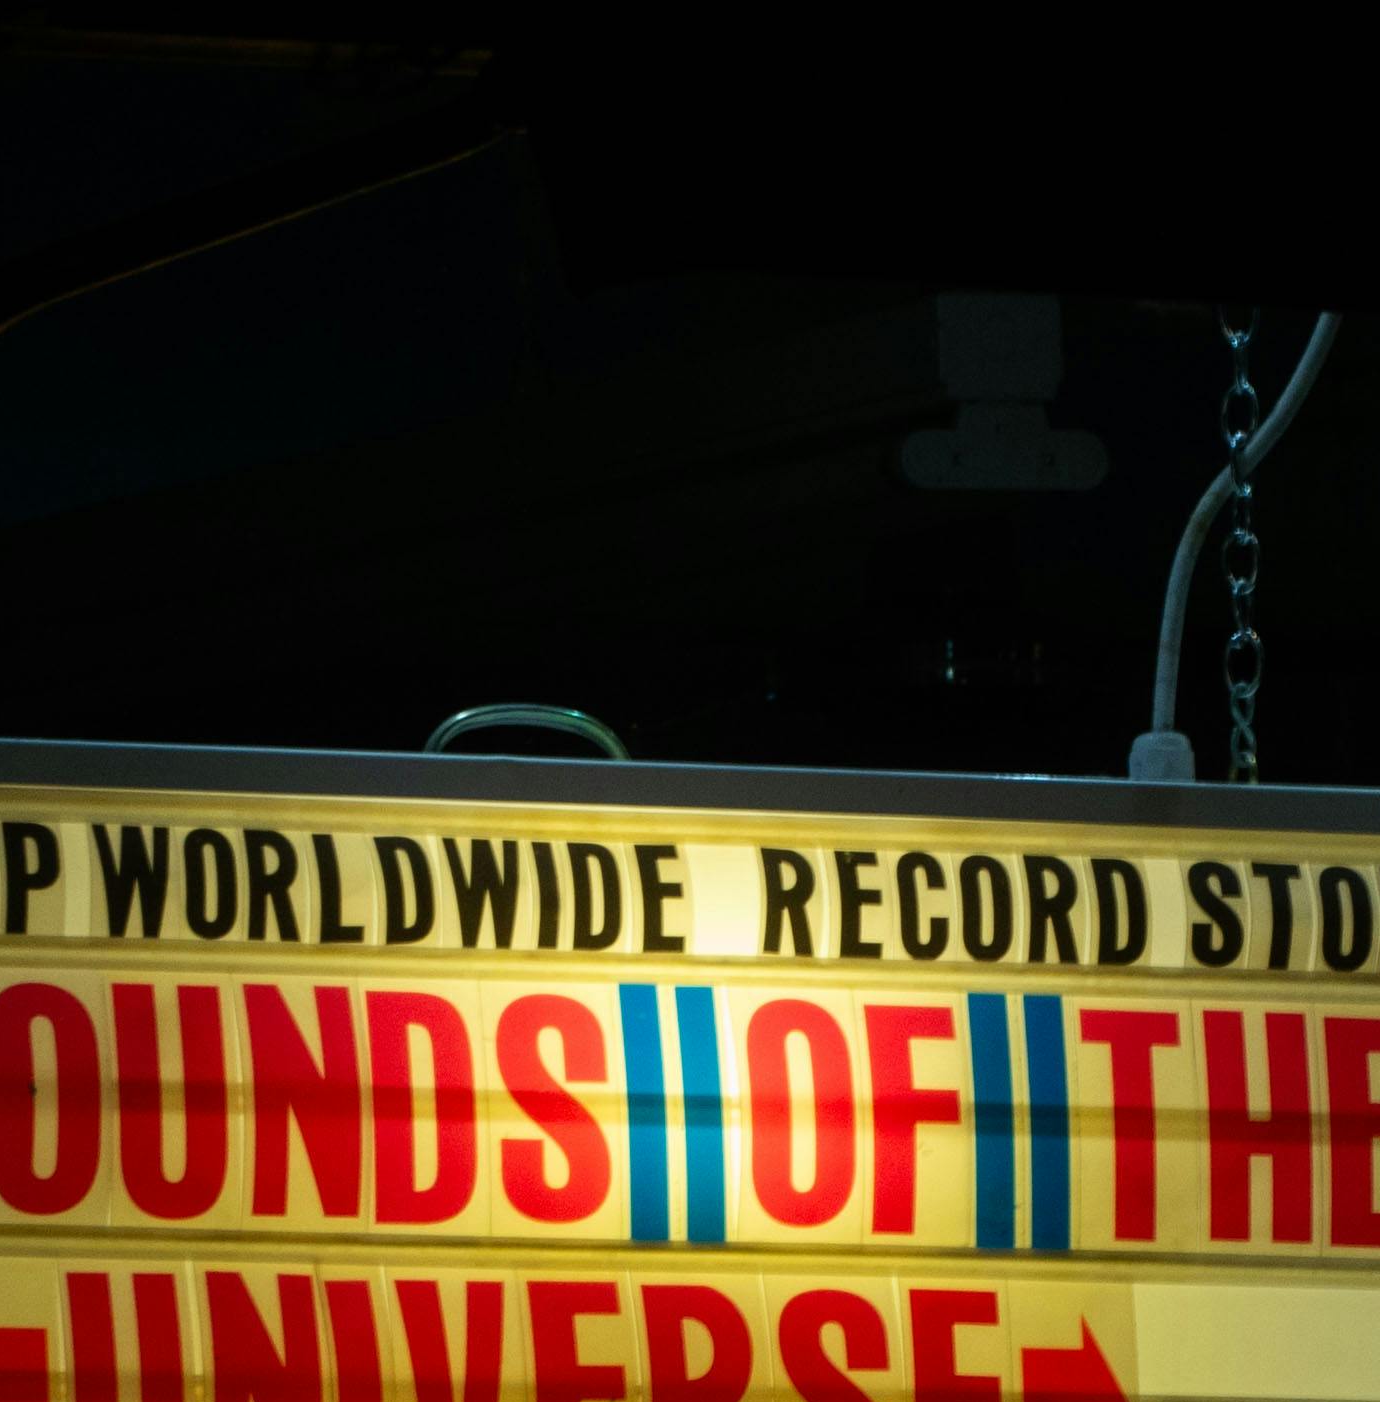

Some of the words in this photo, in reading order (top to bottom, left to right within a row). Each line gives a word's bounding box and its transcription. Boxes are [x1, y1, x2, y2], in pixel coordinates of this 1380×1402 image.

[92, 823, 686, 952] WORLDWIDE
[759, 846, 1150, 970] RECORD
[746, 998, 962, 1236] OF
